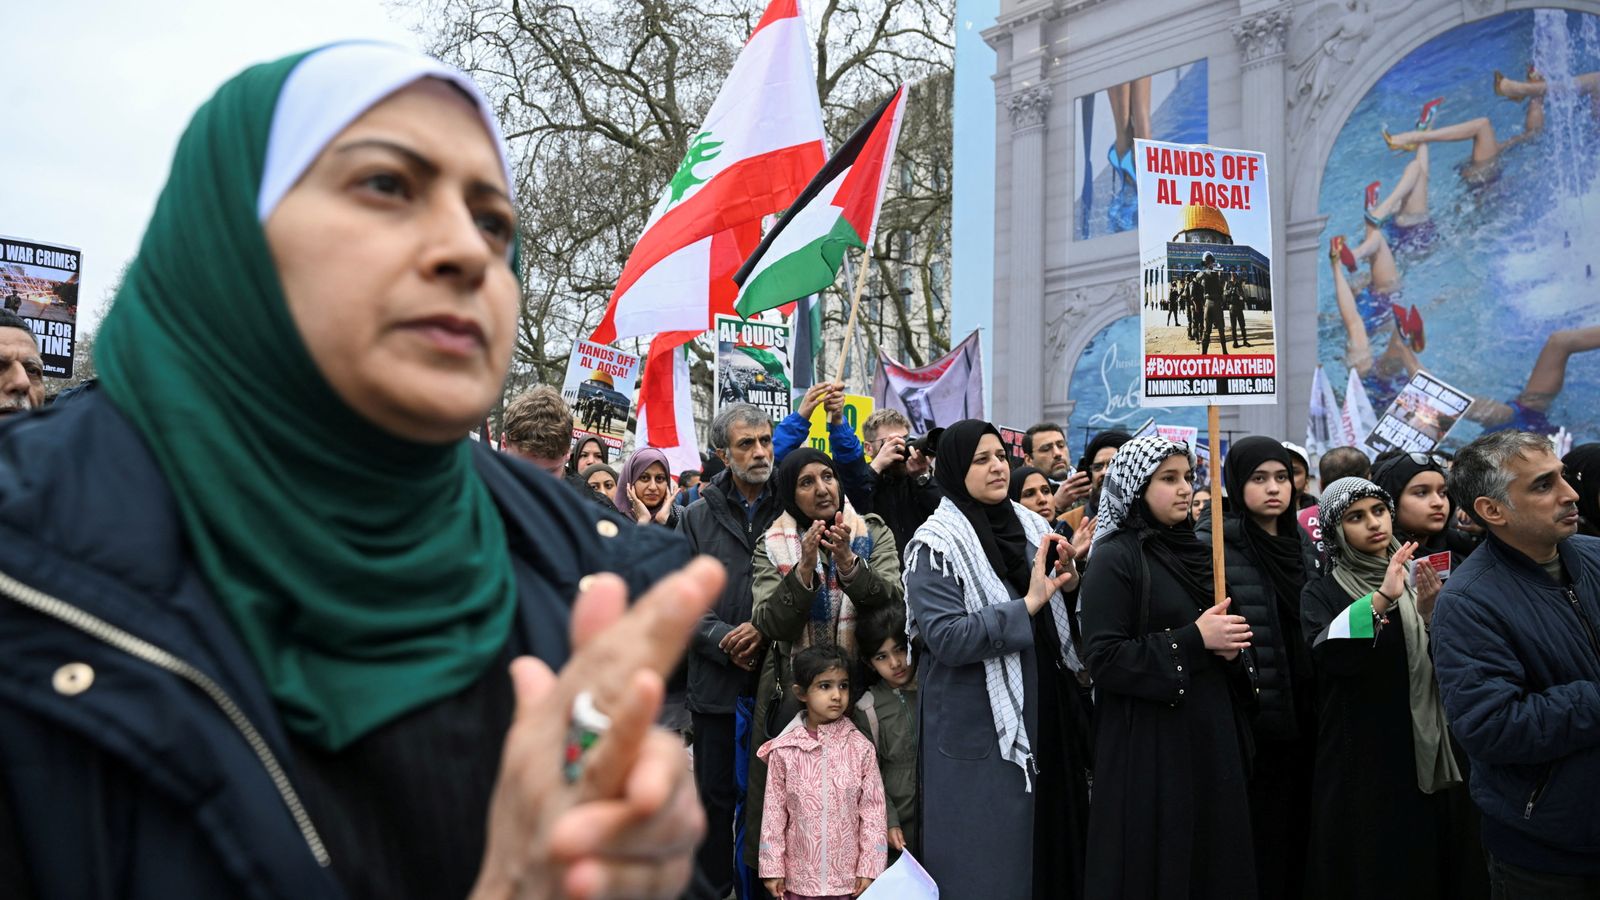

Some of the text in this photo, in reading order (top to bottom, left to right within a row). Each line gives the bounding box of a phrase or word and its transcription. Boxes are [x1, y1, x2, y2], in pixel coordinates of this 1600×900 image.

[1146, 146, 1259, 181] HANDS OFF
[1157, 178, 1251, 210] AL AQSA!
[6, 244, 34, 263] WAR
[35, 248, 77, 271] CRIMES
[48, 321, 72, 338] FOR
[719, 321, 785, 348] AL QUDS
[37, 334, 71, 357] TINE
[577, 342, 636, 368] HANDS OFF
[579, 356, 629, 379] AL AQSA!
[748, 389, 788, 405] WILL BE
[1147, 378, 1274, 395] INMINDS.COM IHRC.ORG
[811, 437, 825, 452] TO
